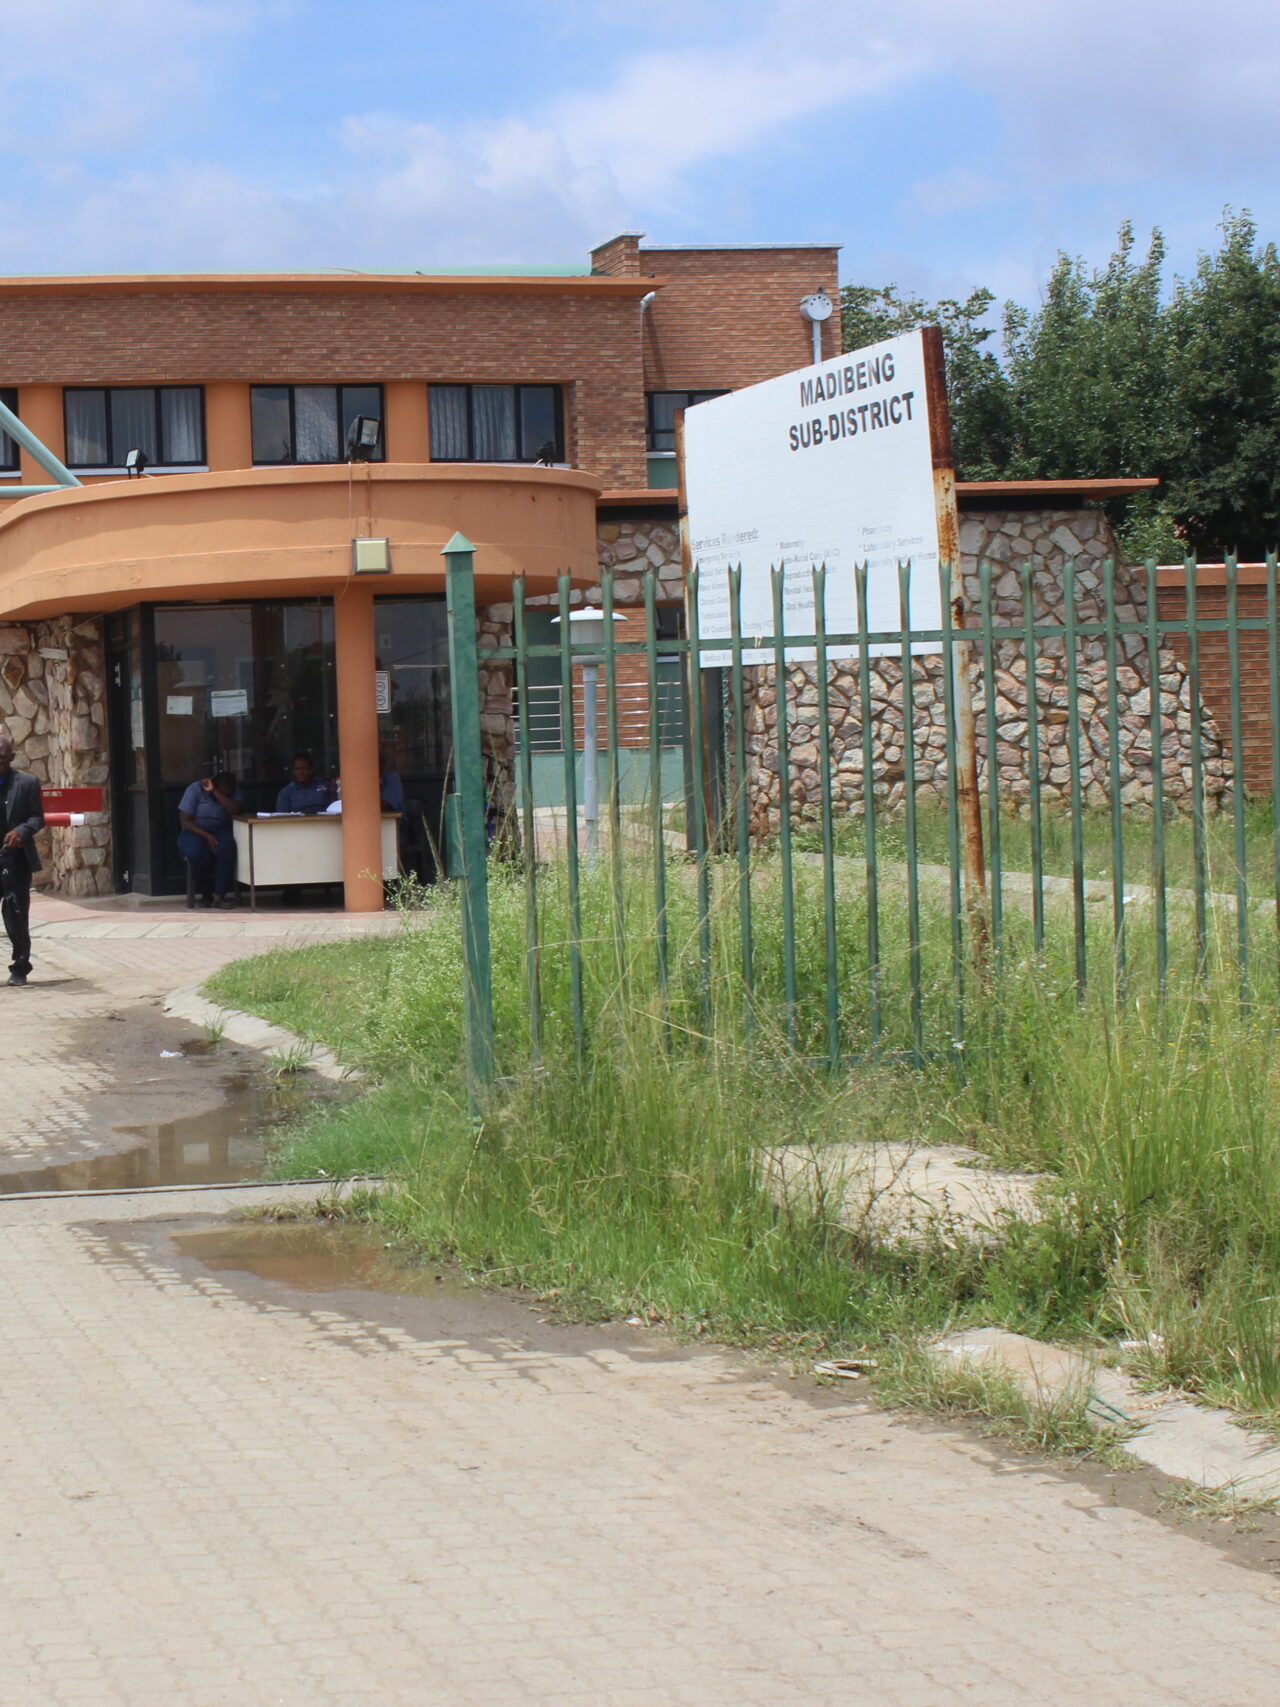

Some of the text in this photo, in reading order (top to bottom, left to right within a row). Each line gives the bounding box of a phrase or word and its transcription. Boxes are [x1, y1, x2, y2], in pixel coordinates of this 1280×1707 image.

[800, 353, 895, 408] MADIBENG
[789, 391, 914, 451] SUB-DISTRICT
[721, 527, 759, 545] Rdered:
